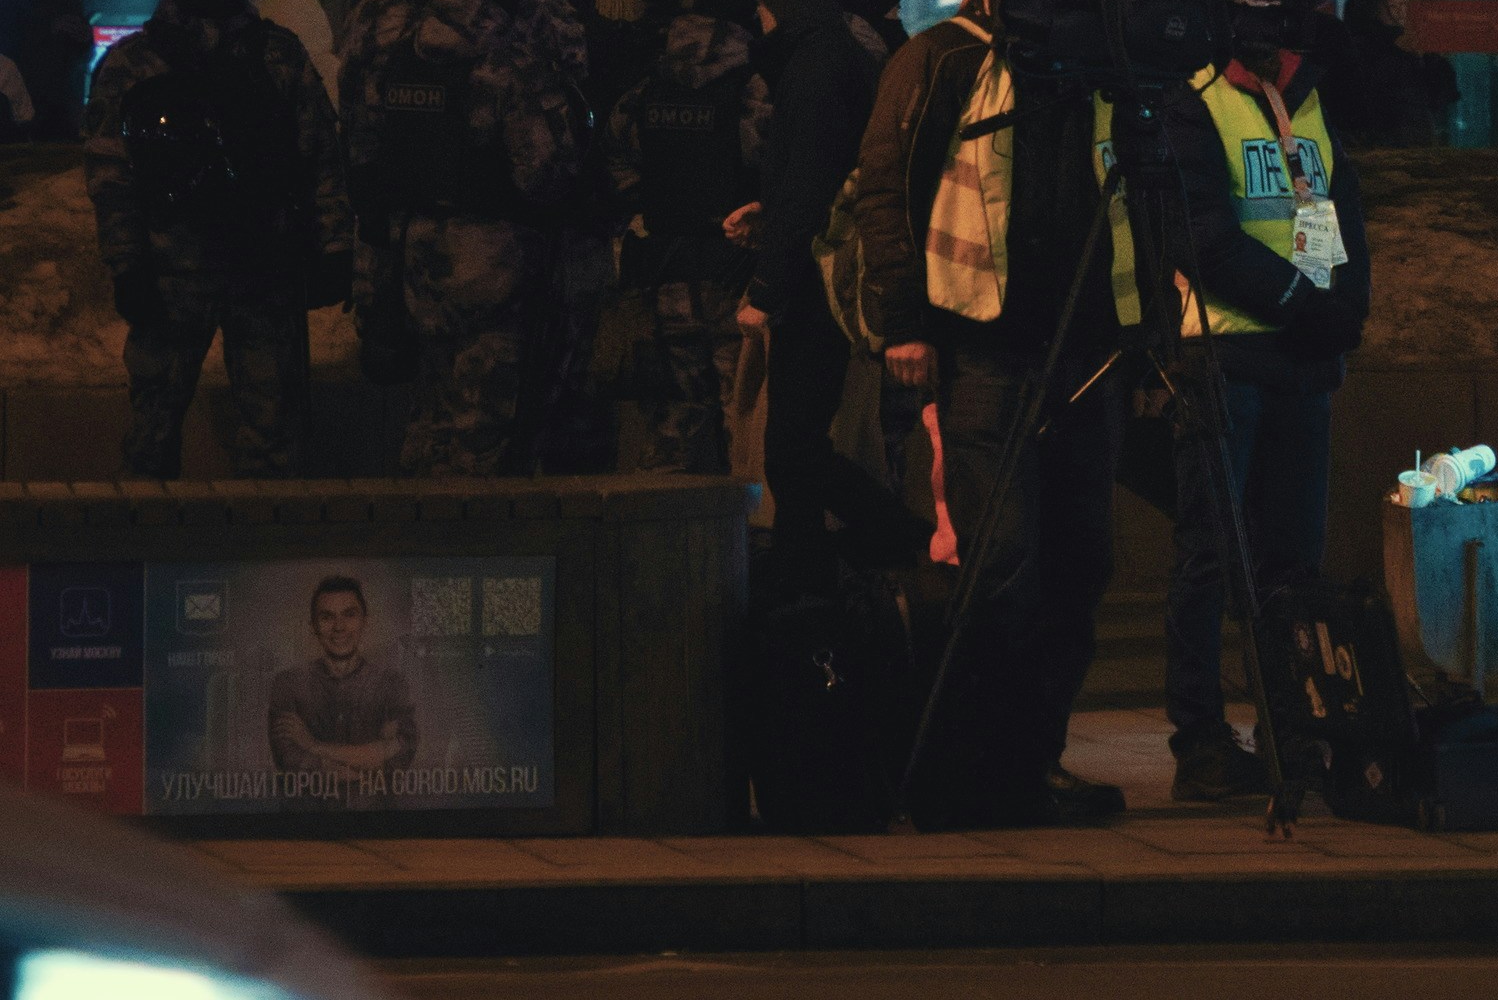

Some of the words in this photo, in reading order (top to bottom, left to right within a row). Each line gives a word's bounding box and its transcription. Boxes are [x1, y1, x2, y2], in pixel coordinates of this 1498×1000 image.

[387, 90, 442, 108] ОМОН
[648, 107, 713, 126] ОМОН
[271, 770, 340, 801] ГОРОД
[358, 768, 388, 796] НА
[391, 765, 539, 796] GOROD.MOS.RU
